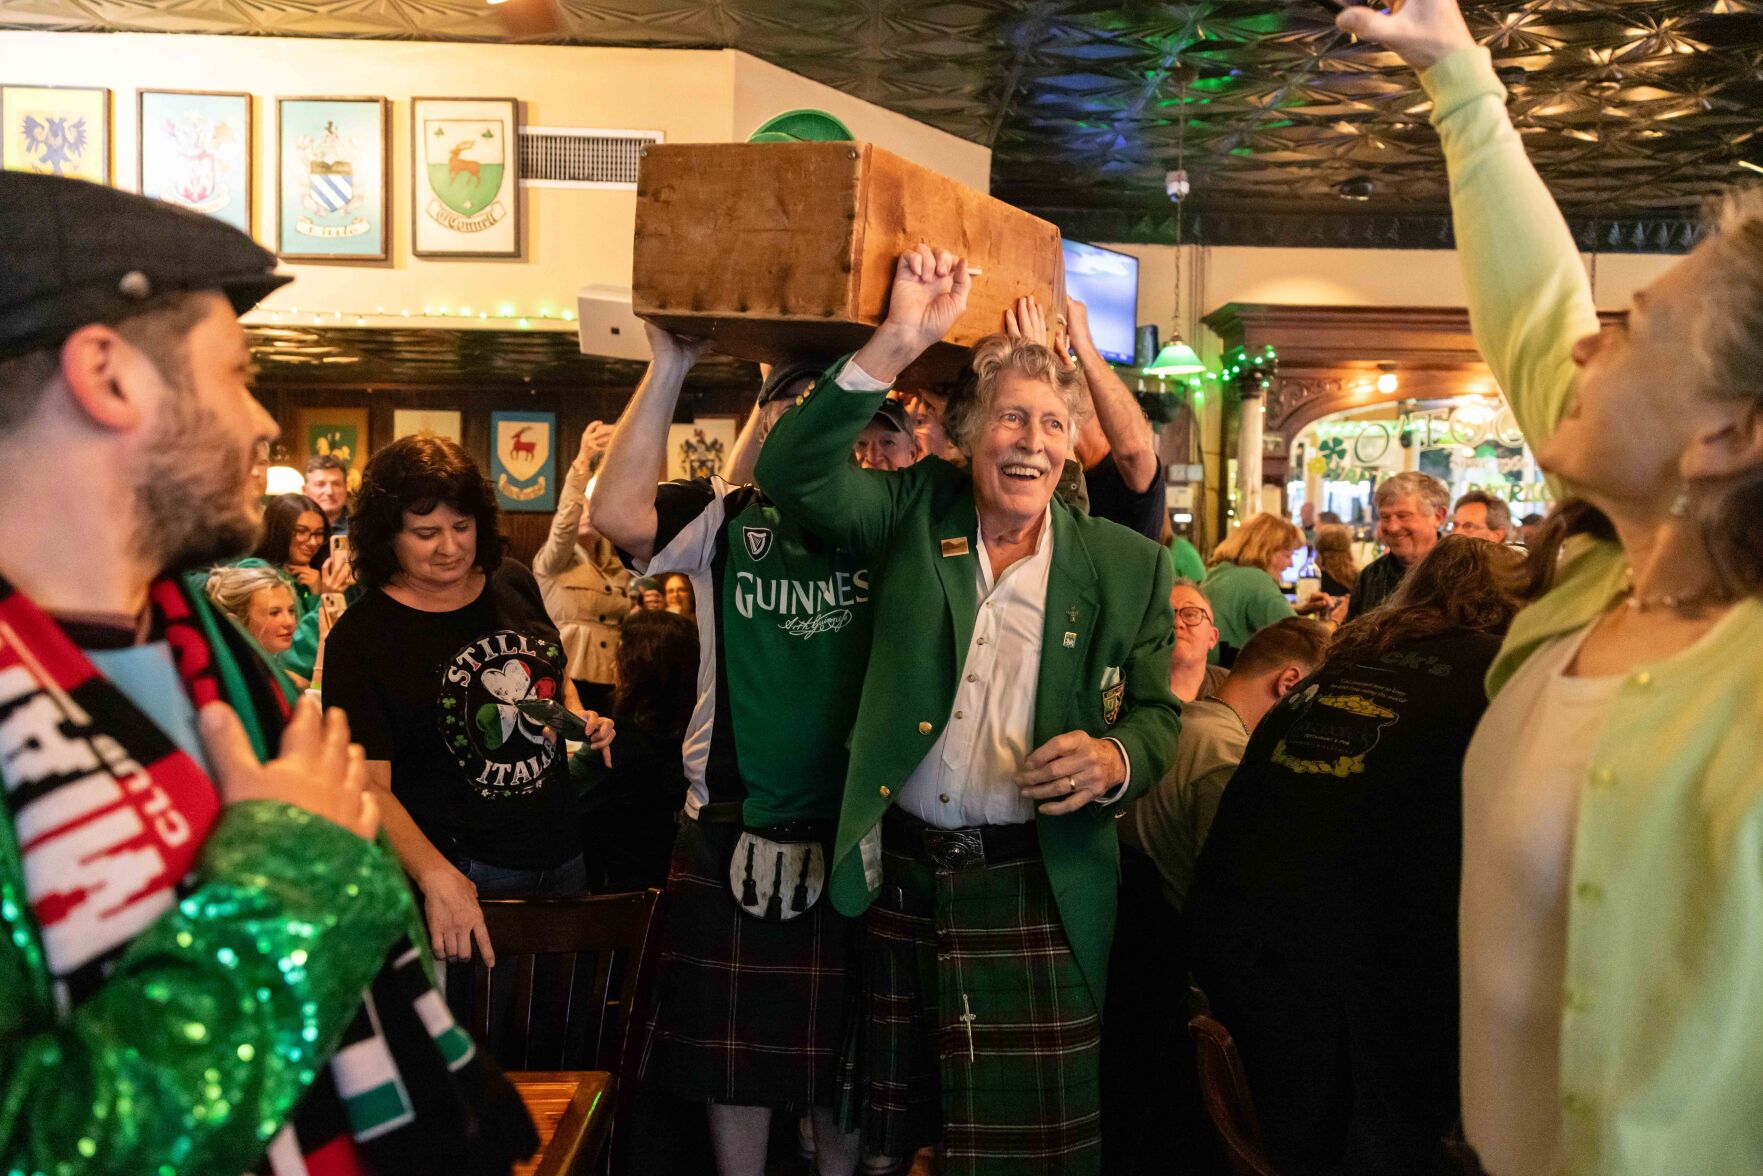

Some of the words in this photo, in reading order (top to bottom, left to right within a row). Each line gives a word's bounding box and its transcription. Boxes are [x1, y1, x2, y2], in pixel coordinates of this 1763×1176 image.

[735, 568, 869, 619] GUINNES
[447, 634, 537, 688] STILL
[476, 739, 557, 786] ITALIA
